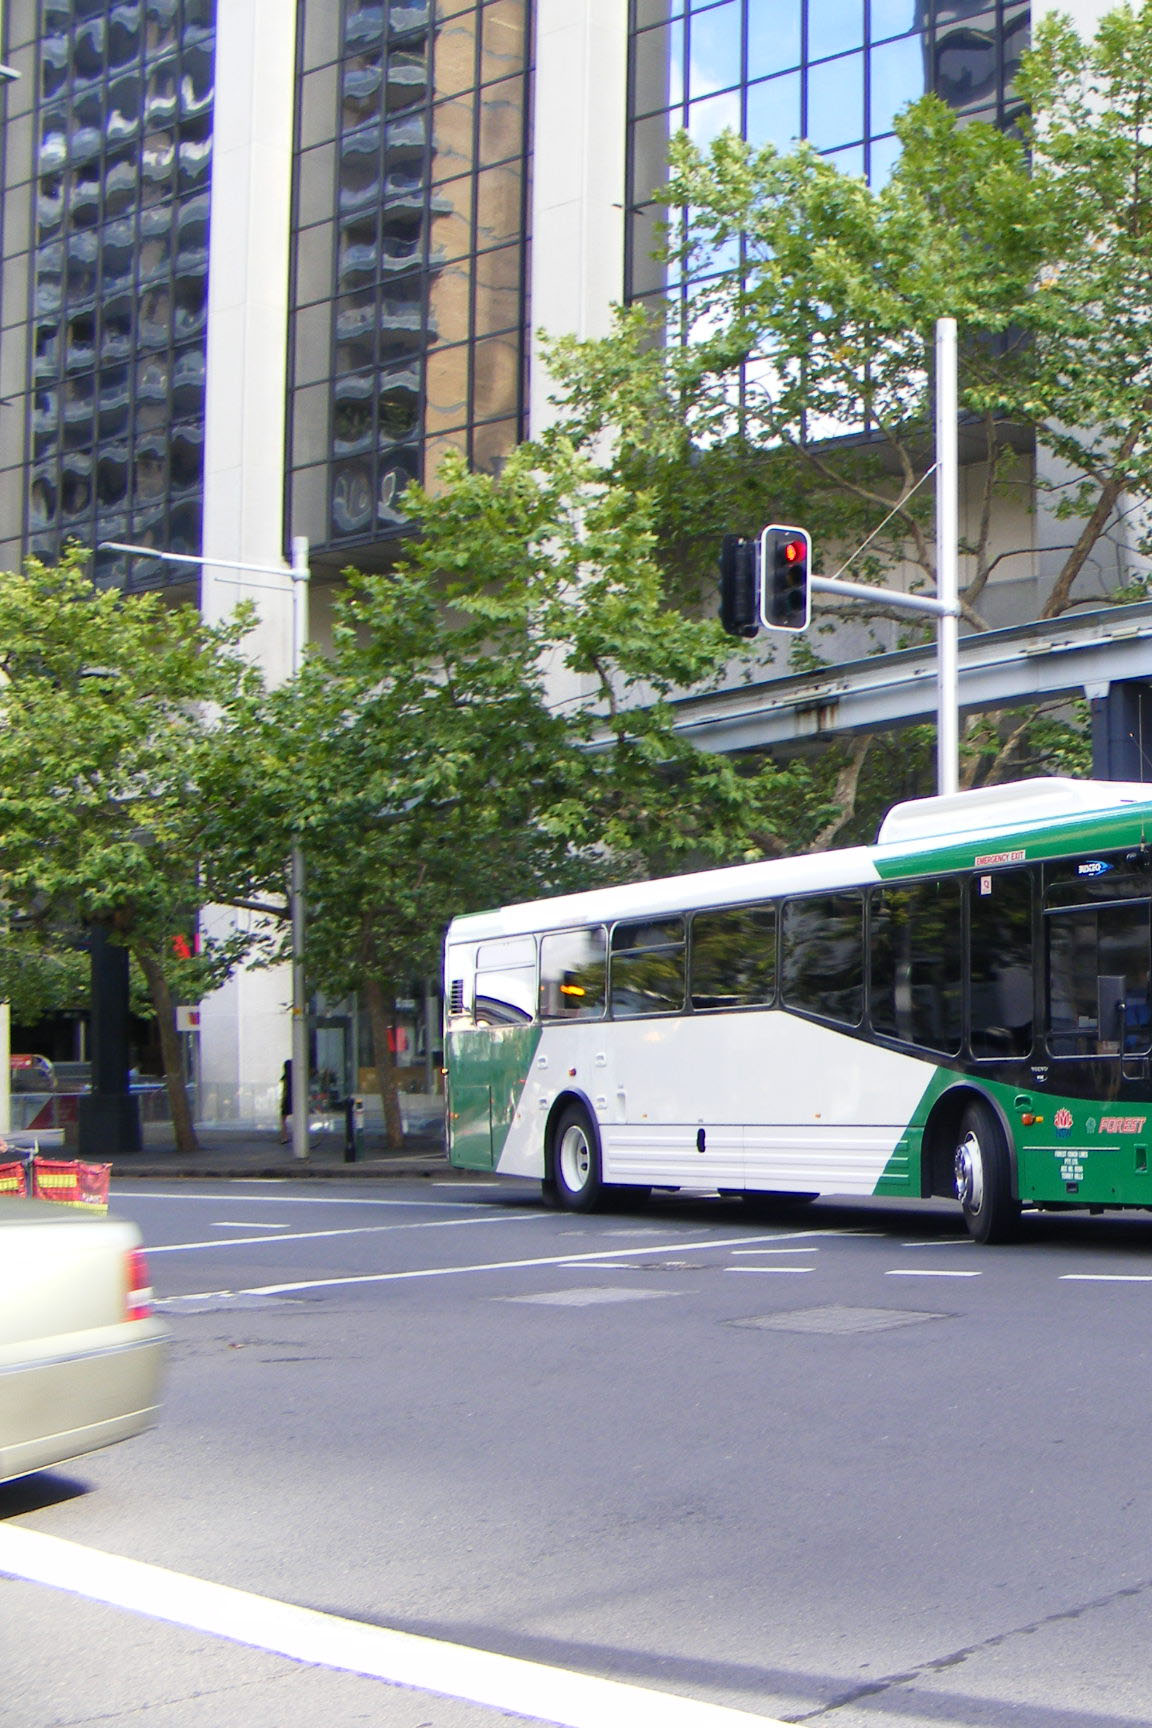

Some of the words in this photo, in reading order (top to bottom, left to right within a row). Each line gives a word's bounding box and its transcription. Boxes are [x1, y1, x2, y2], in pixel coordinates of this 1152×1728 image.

[976, 853, 1009, 866] EMERGENCY
[1011, 851, 1024, 861] EXIT
[1098, 1116, 1146, 1133] FOREST
